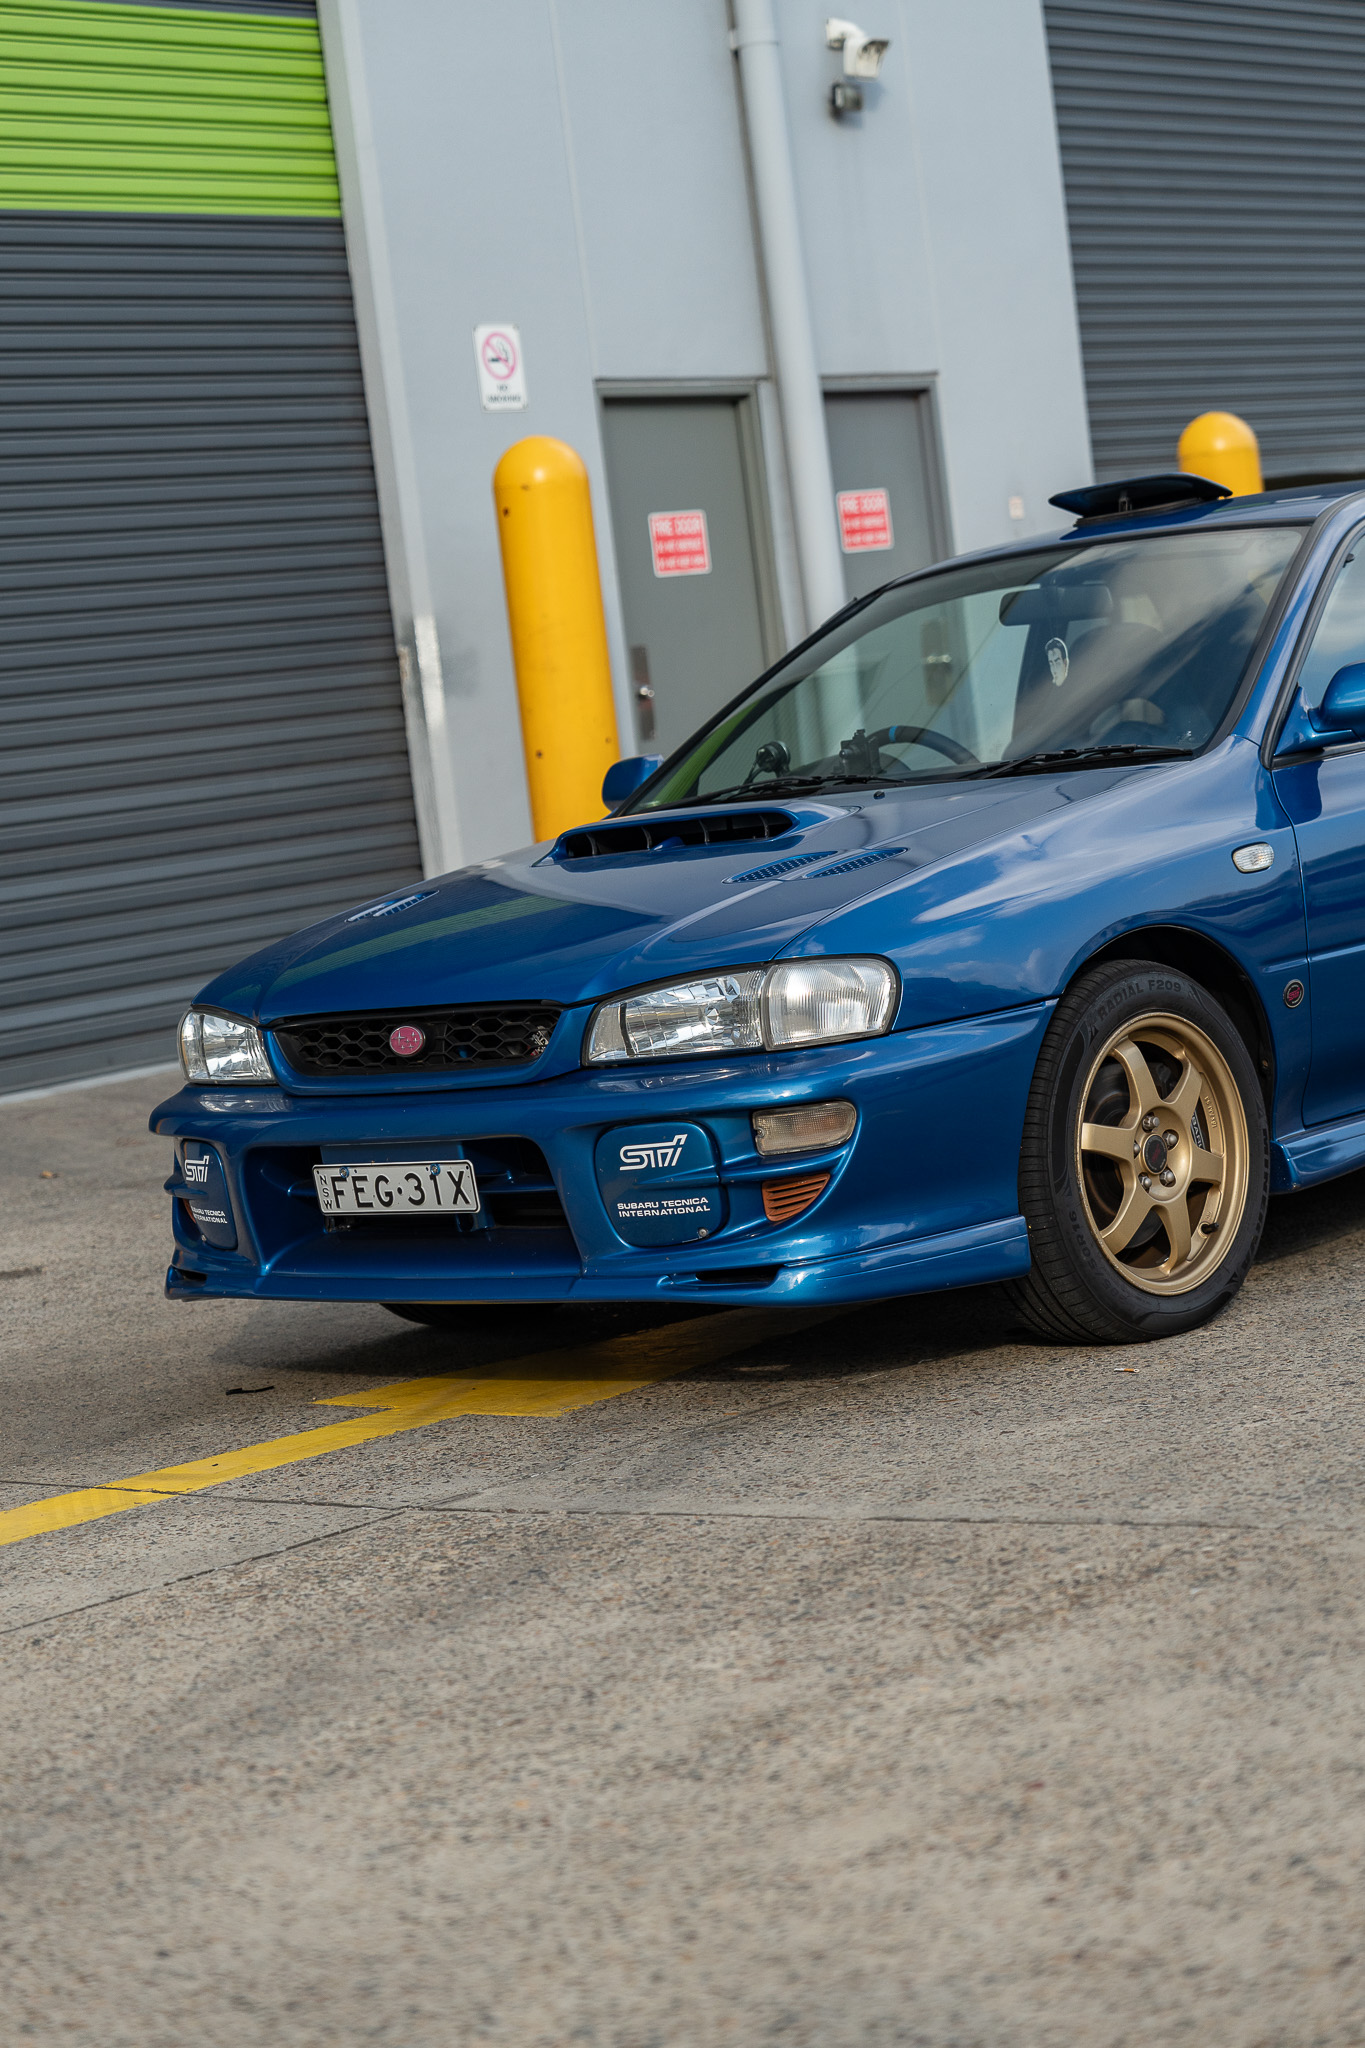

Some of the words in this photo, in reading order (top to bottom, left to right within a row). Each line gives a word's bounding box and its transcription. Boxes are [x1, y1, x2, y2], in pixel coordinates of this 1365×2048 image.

[1098, 982, 1144, 1019] RADIAL
[1148, 980, 1181, 992] F209
[617, 1201, 659, 1210] SUBARU
[661, 1197, 709, 1207] TECNICA
[204, 1209, 226, 1217] TECNICA
[619, 1205, 711, 1217] INTERNATIONAL
